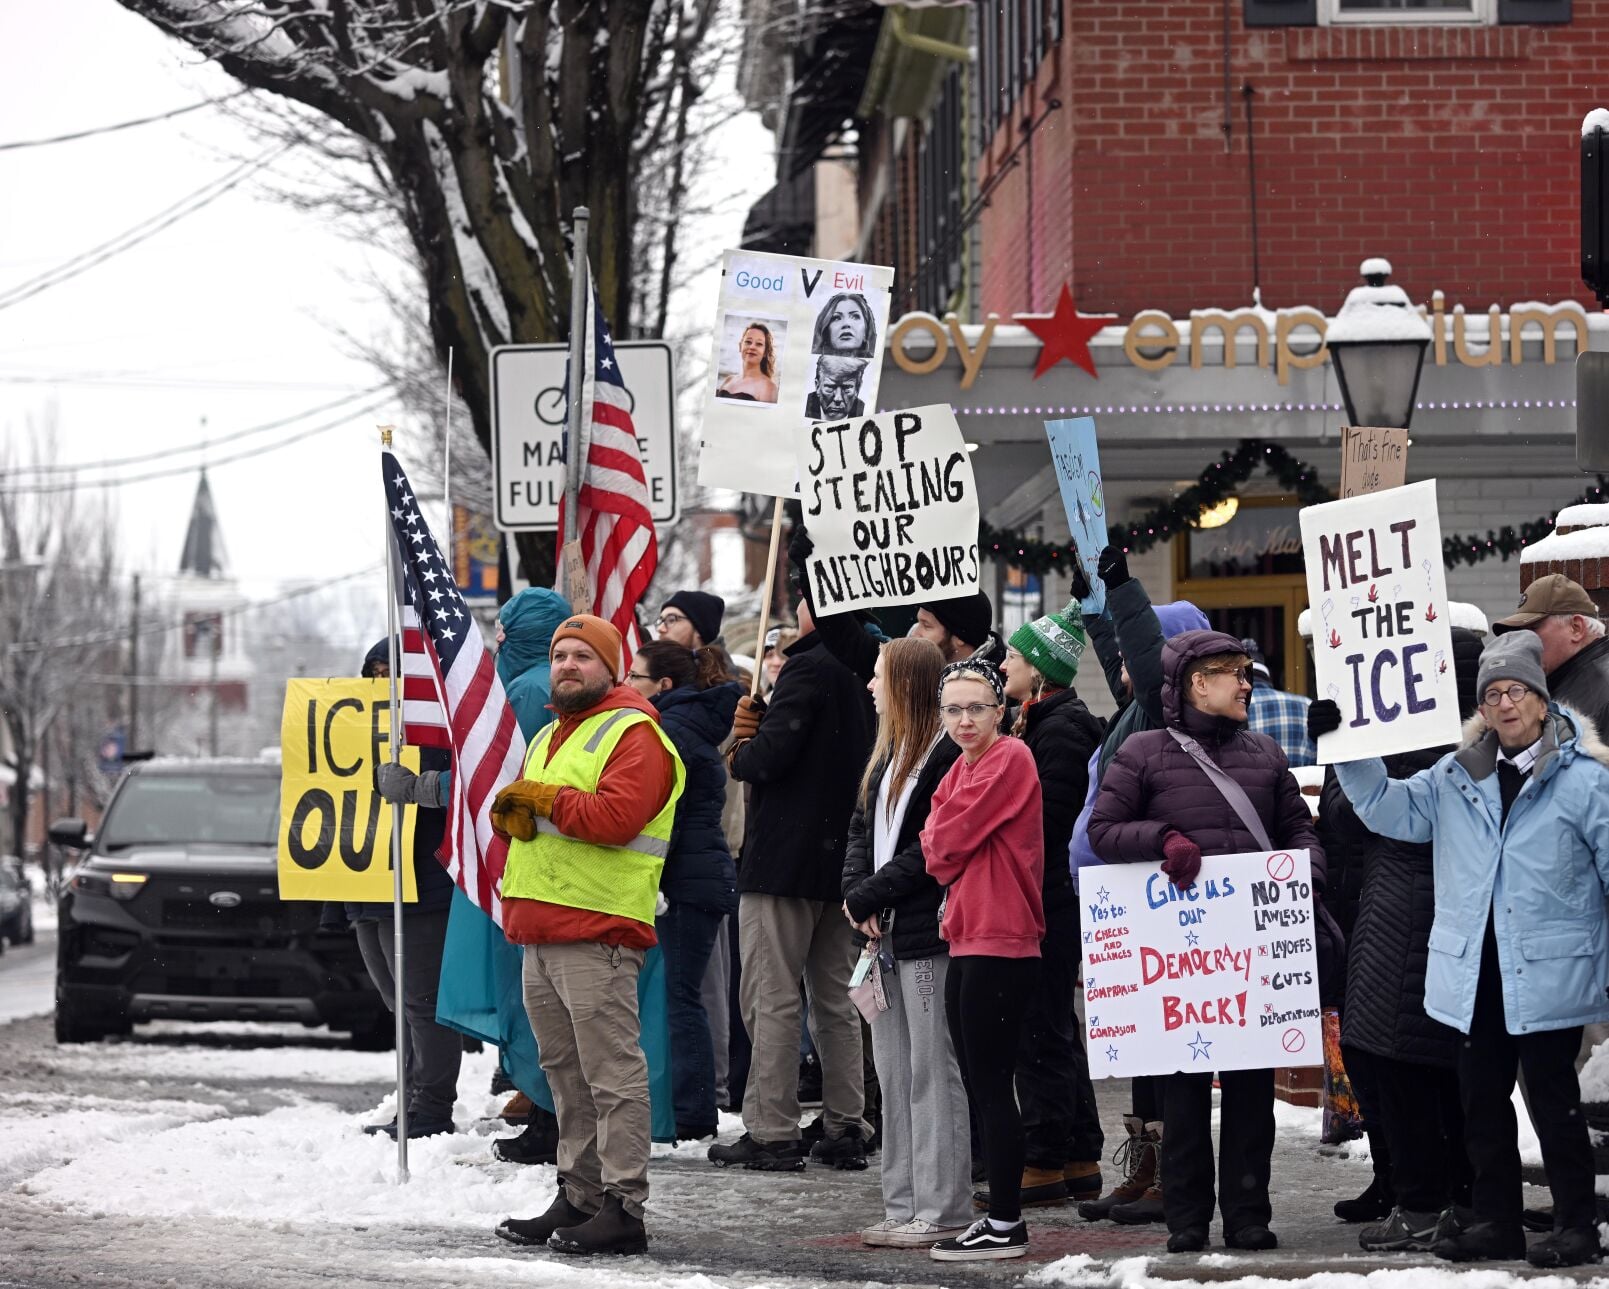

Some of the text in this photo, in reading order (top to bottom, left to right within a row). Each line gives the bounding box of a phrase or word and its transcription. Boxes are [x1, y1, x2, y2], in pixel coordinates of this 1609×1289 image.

[737, 268, 865, 299] Good V Evil
[891, 297, 1590, 391] oy empium
[523, 440, 564, 467] MA
[808, 412, 922, 476] STOP
[1382, 429, 1402, 463] fine
[510, 480, 559, 507] FUL
[808, 451, 966, 516] STEALING
[853, 514, 915, 551] OUR
[1319, 519, 1416, 592] MELT
[813, 544, 978, 608] NEIGHBOURS
[1351, 601, 1414, 639] THE
[1345, 642, 1437, 728] ICE
[1205, 876, 1235, 900] us
[1251, 880, 1310, 907] NO TO
[1088, 903, 1109, 923] Yes
[1178, 907, 1207, 927] our
[1253, 908, 1310, 932] LAWLESS:
[1094, 926, 1130, 942] CHECKS
[1103, 940, 1123, 951] AND
[1088, 949, 1133, 965] BALANCES
[1271, 938, 1313, 960] LAYOFFS
[914, 959, 935, 996] ERO
[1139, 942, 1252, 986] DEMOCRACY
[1087, 983, 1139, 1002] COMPROMISE
[1271, 970, 1313, 991] CUTS
[1162, 990, 1248, 1032] BACK!
